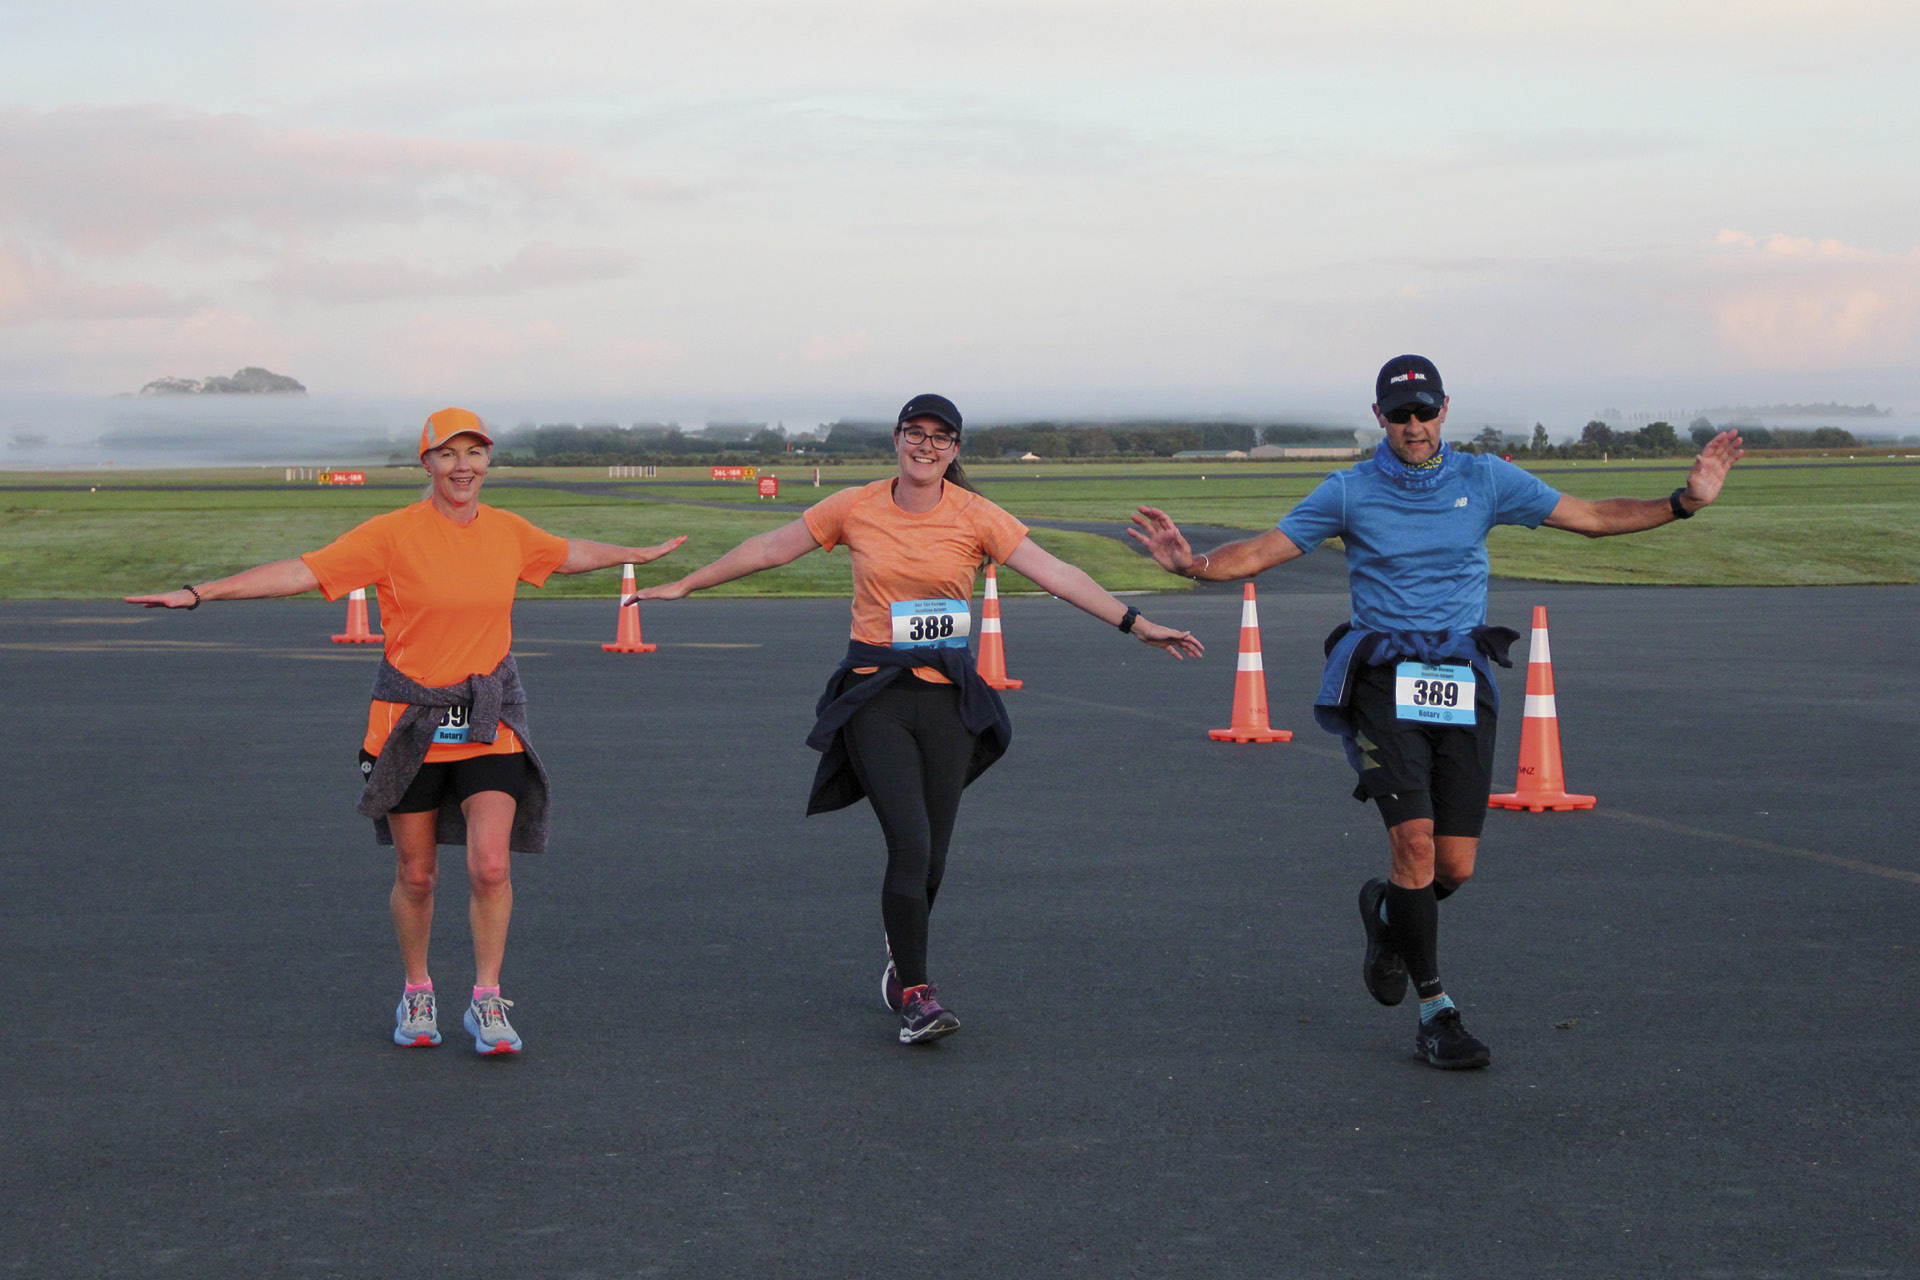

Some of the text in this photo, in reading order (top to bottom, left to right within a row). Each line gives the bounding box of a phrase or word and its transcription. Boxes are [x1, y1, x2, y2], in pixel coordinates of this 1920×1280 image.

[910, 614, 954, 641] 388
[1413, 679, 1459, 707] 389
[1418, 709, 1440, 719] Rotary
[440, 731, 463, 740] Rotary
